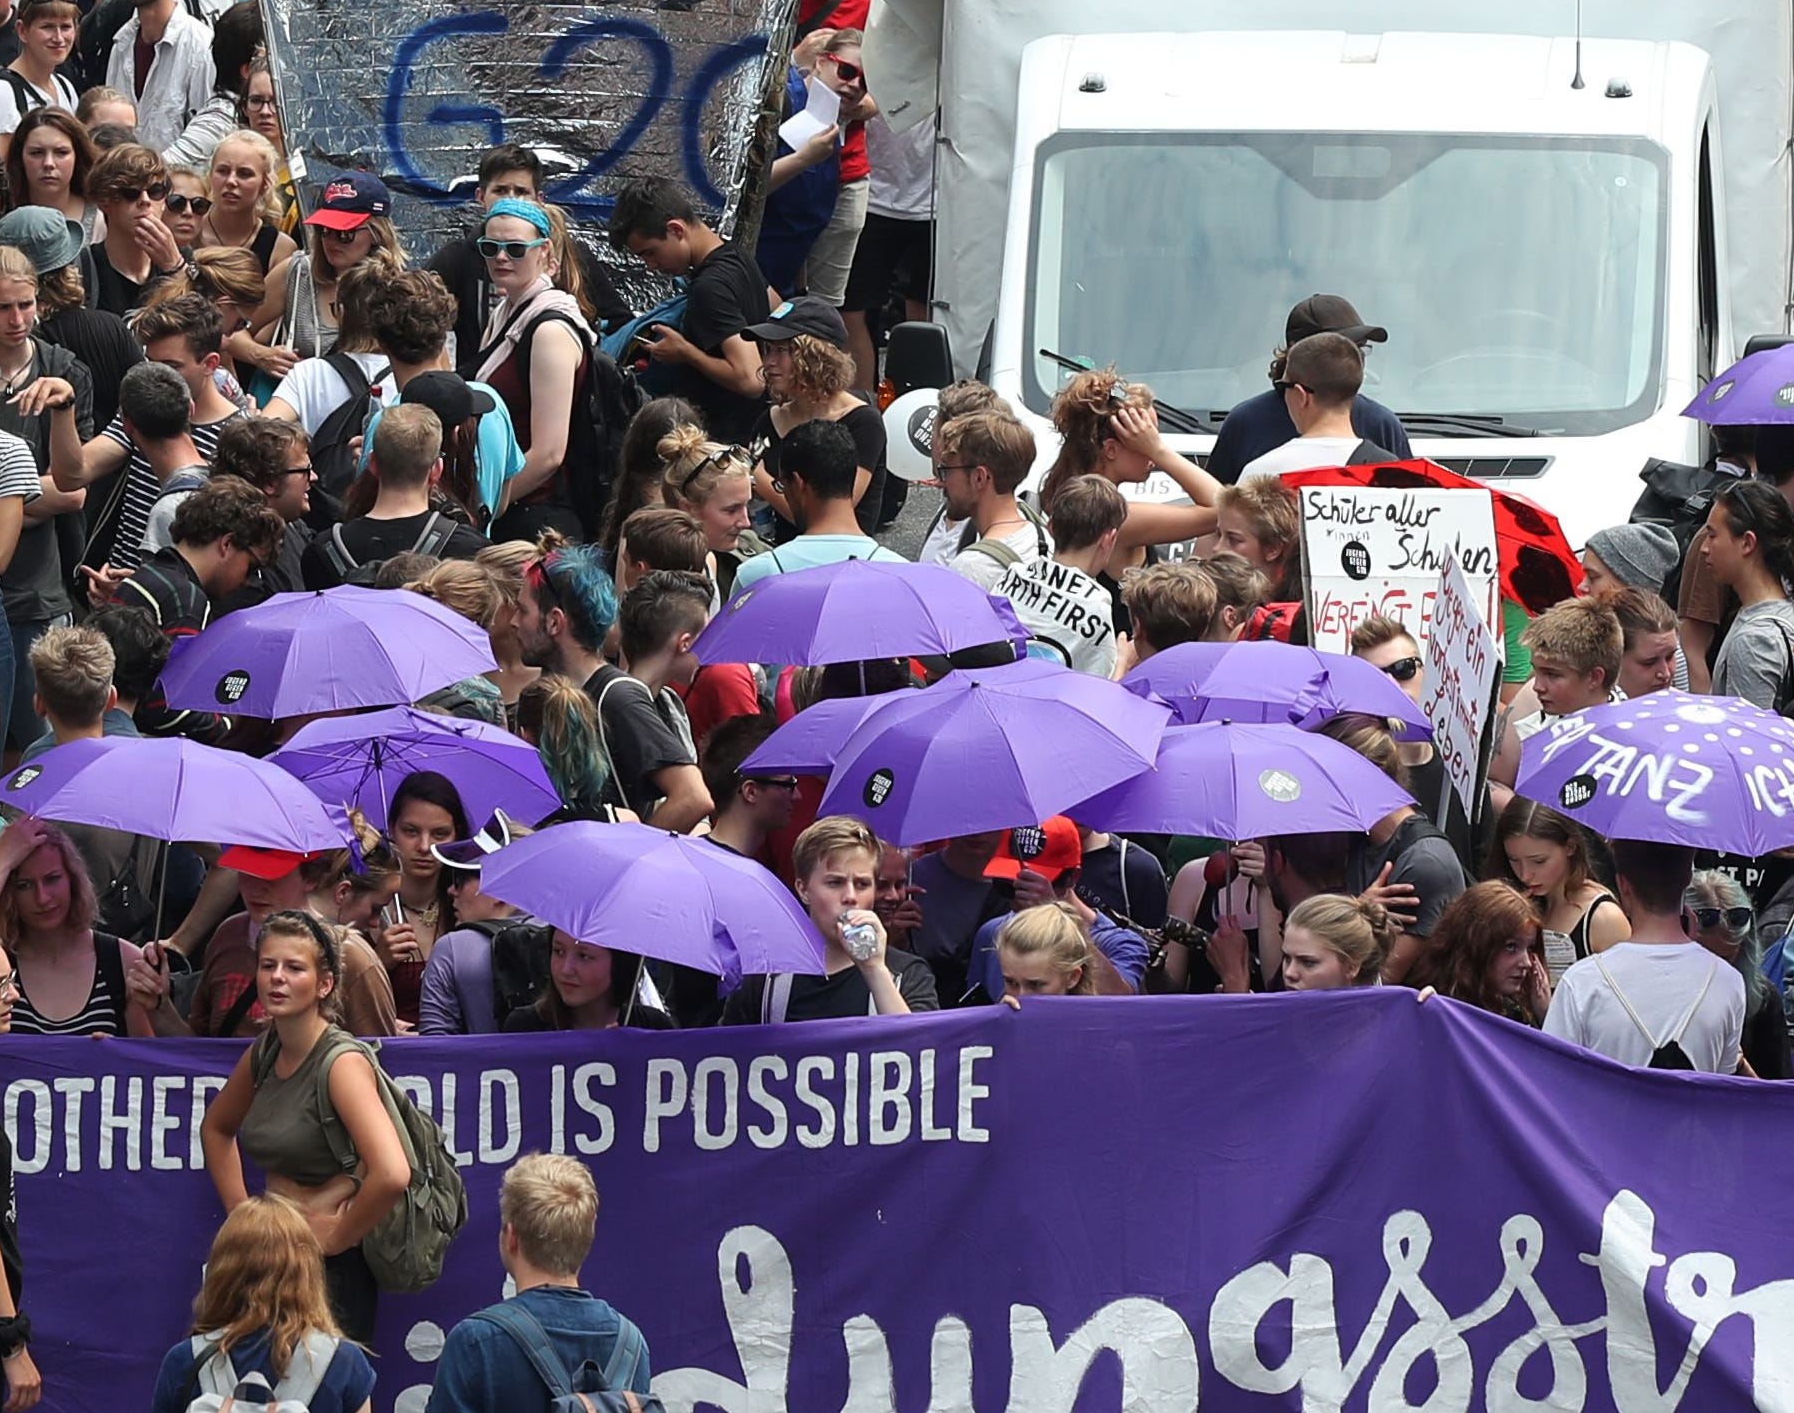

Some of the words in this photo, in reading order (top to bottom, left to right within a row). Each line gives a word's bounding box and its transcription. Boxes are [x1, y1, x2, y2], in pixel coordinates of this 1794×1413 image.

[1305, 490, 1382, 528] Schüler
[1384, 495, 1442, 529] aller
[1048, 589, 1113, 648] FIRST
[1588, 724, 1712, 823] TANZ
[551, 1061, 618, 1156] IS
[643, 1045, 997, 1154] POSSIBLE
